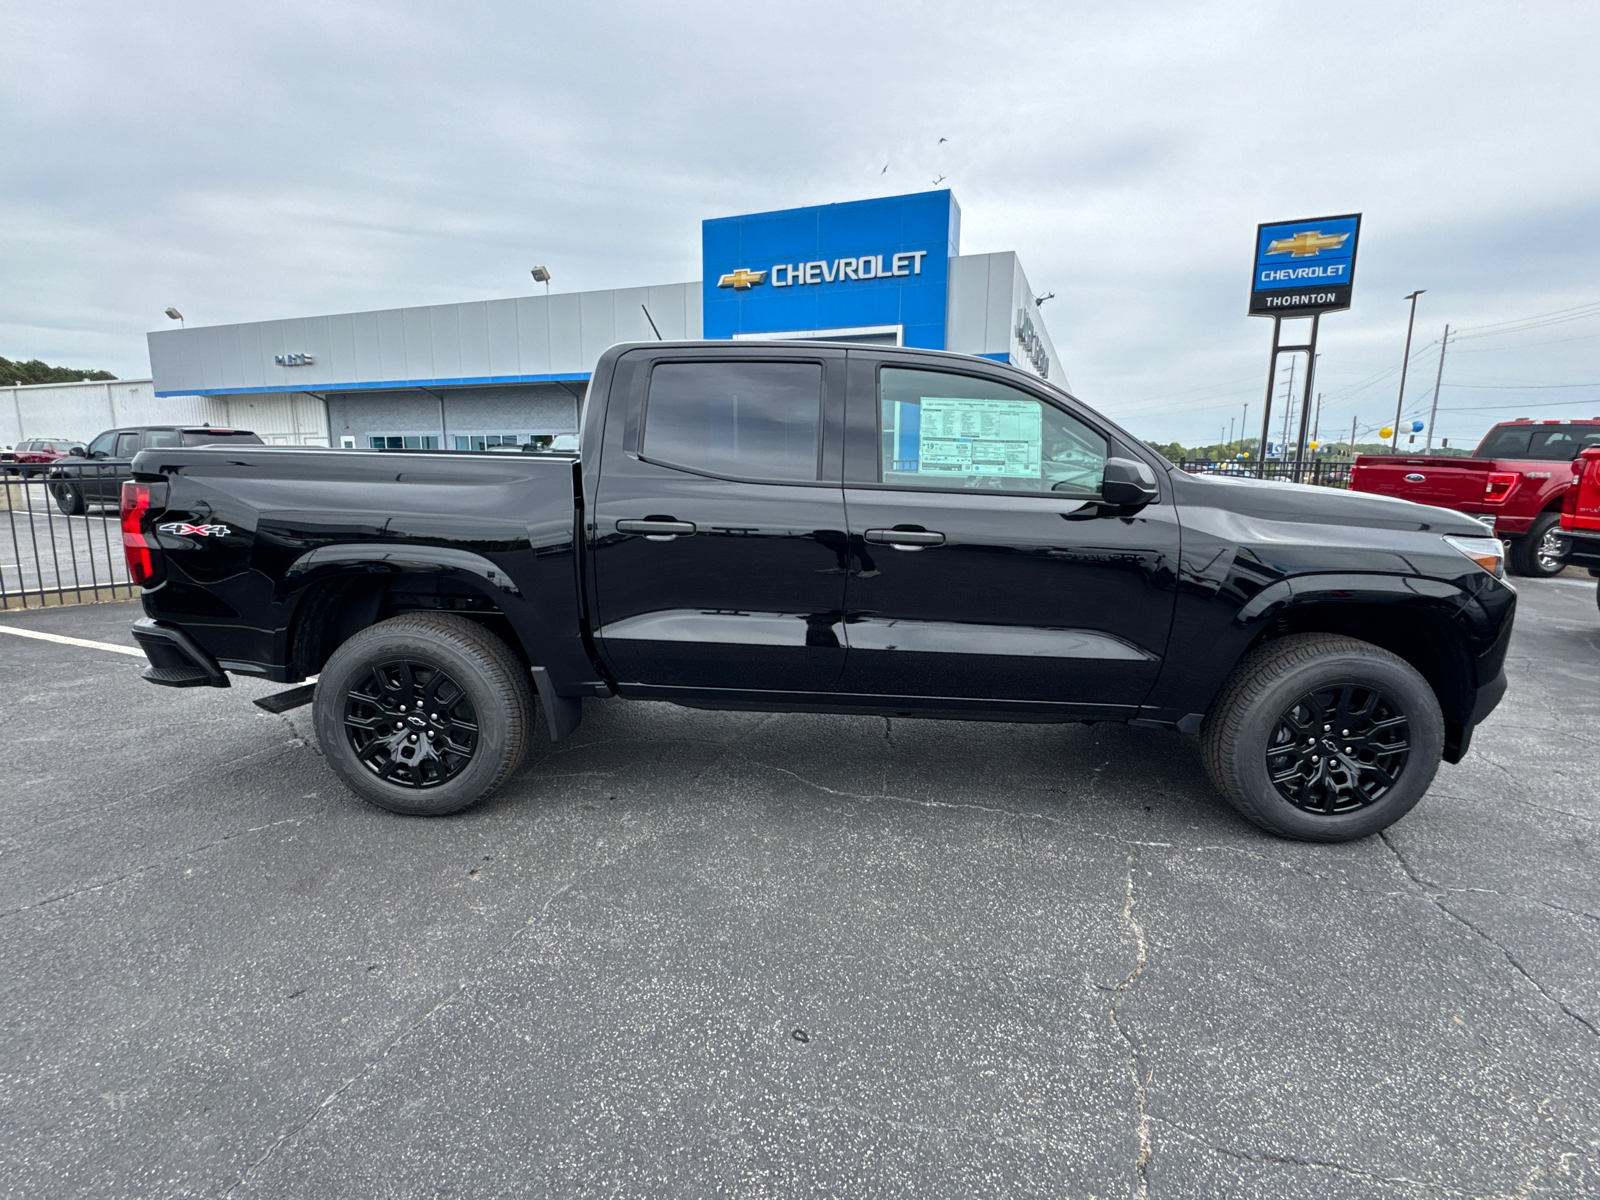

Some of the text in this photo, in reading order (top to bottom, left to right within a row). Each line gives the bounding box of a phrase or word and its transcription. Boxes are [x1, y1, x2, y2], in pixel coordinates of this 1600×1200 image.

[771, 250, 927, 287] CHEVROLET
[1261, 264, 1346, 281] CHEVROLET
[1266, 293, 1336, 307] THORNTON
